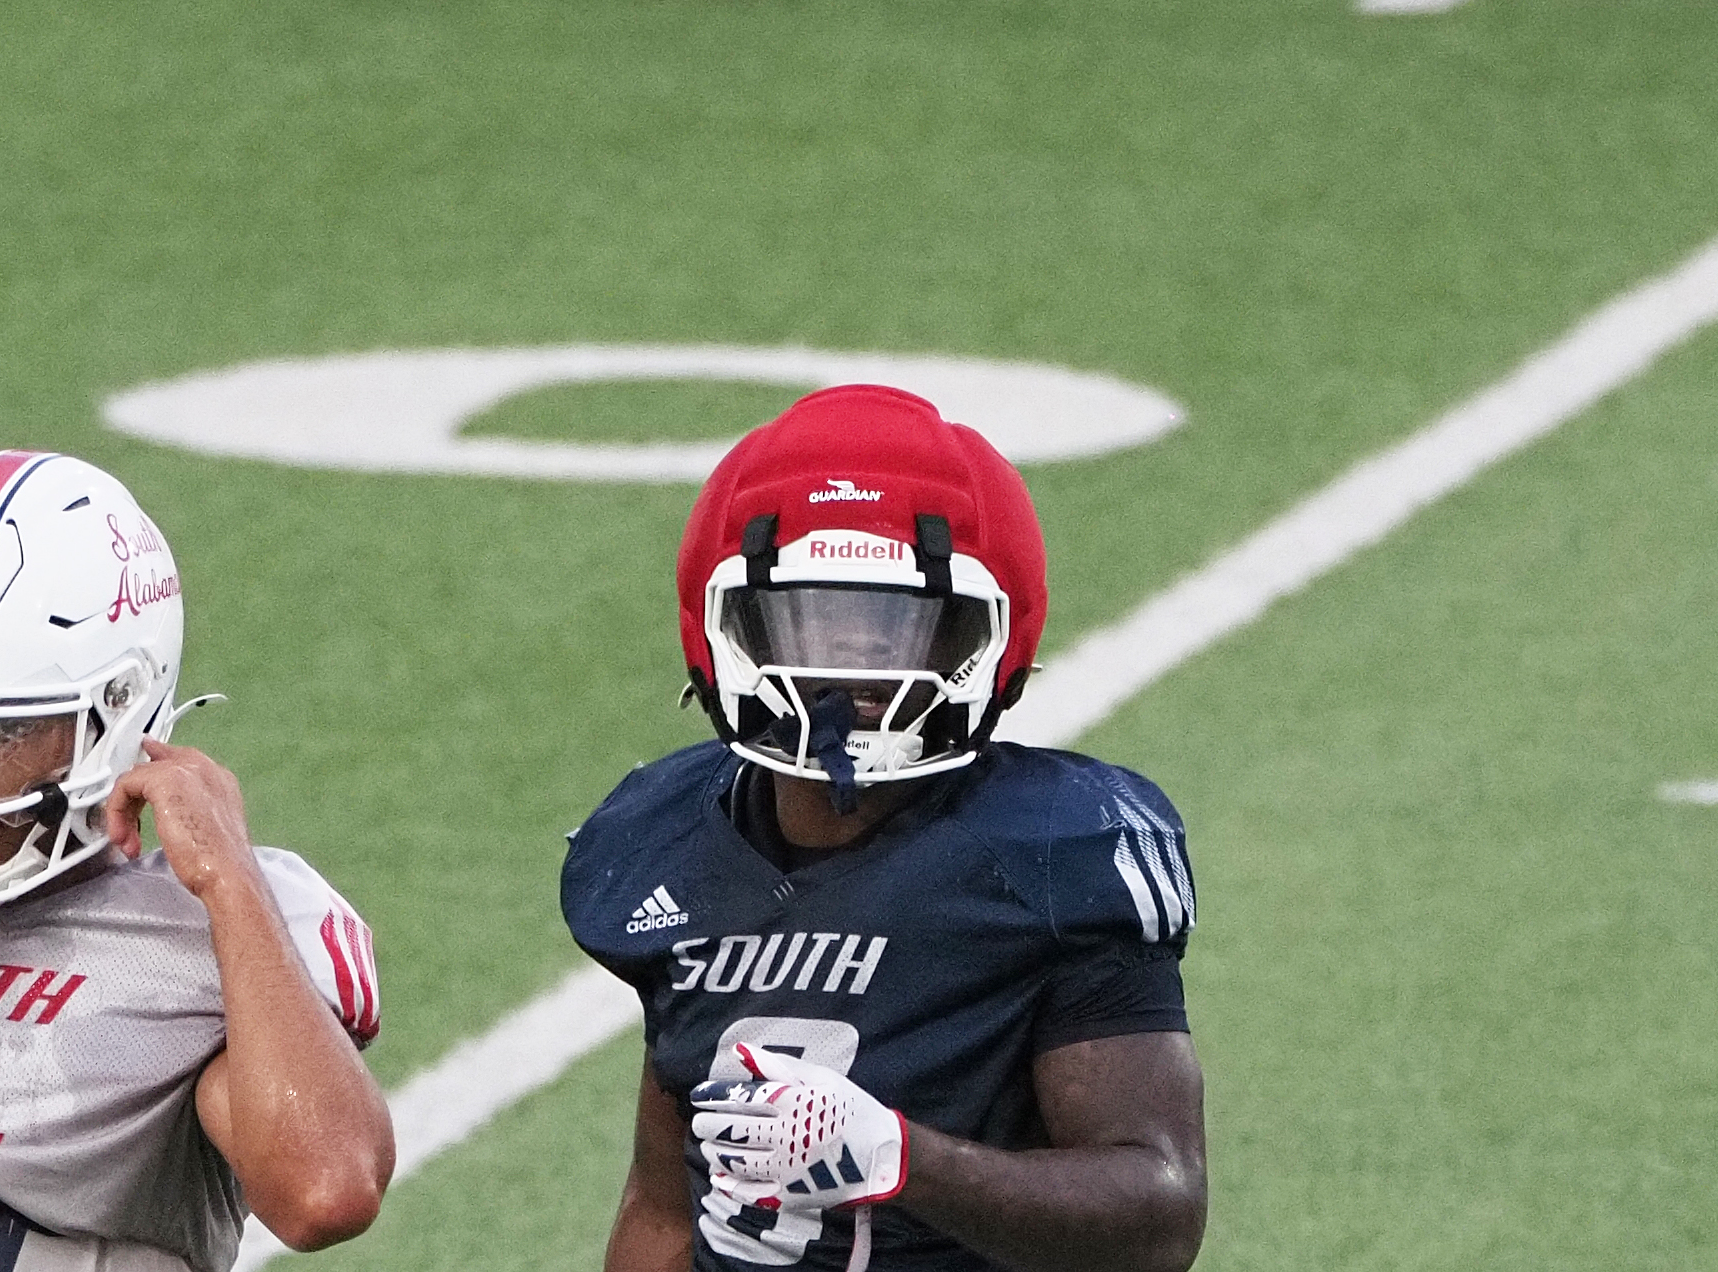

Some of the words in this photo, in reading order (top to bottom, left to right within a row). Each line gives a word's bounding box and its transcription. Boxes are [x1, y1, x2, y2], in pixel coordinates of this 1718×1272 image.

[809, 489, 881, 503] GUARDIAN
[810, 541, 903, 560] Riddell
[626, 912, 689, 934] adidas
[671, 931, 888, 995] SOUTH
